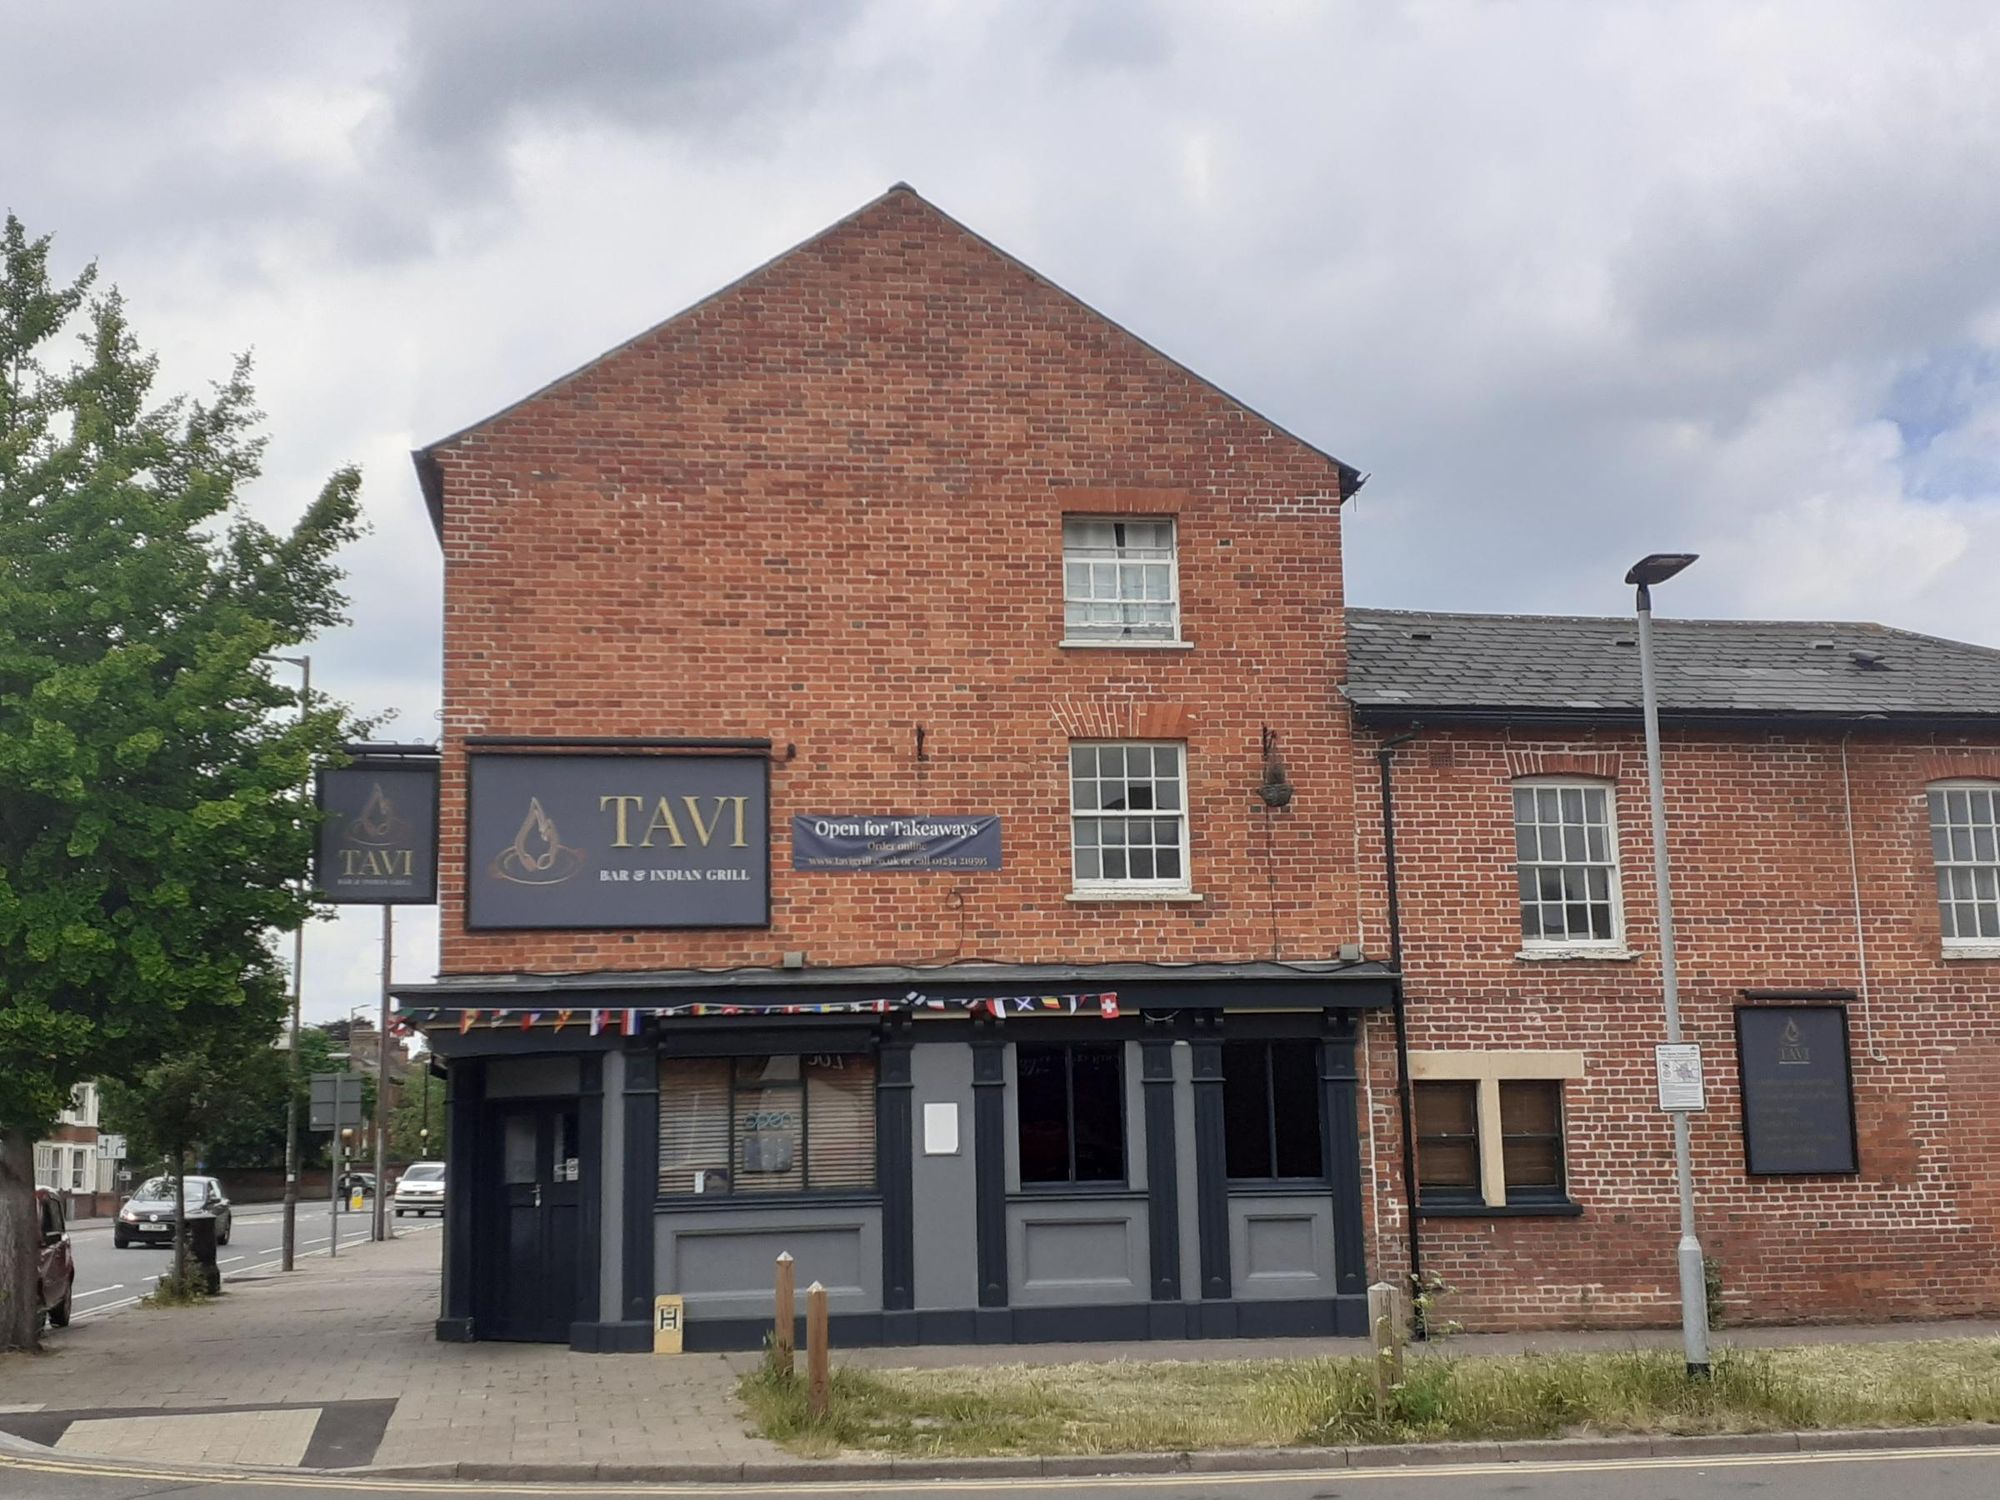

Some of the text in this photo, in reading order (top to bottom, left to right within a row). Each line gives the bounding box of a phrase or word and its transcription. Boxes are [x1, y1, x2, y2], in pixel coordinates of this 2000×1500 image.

[600, 795, 750, 848] TAVI
[815, 820, 978, 839] Open for Takeaways
[867, 841, 927, 851] Order online
[339, 849, 414, 876] TAVI
[600, 869, 750, 881] BAR & INDIAN GRILL
[660, 1308, 677, 1330] H
